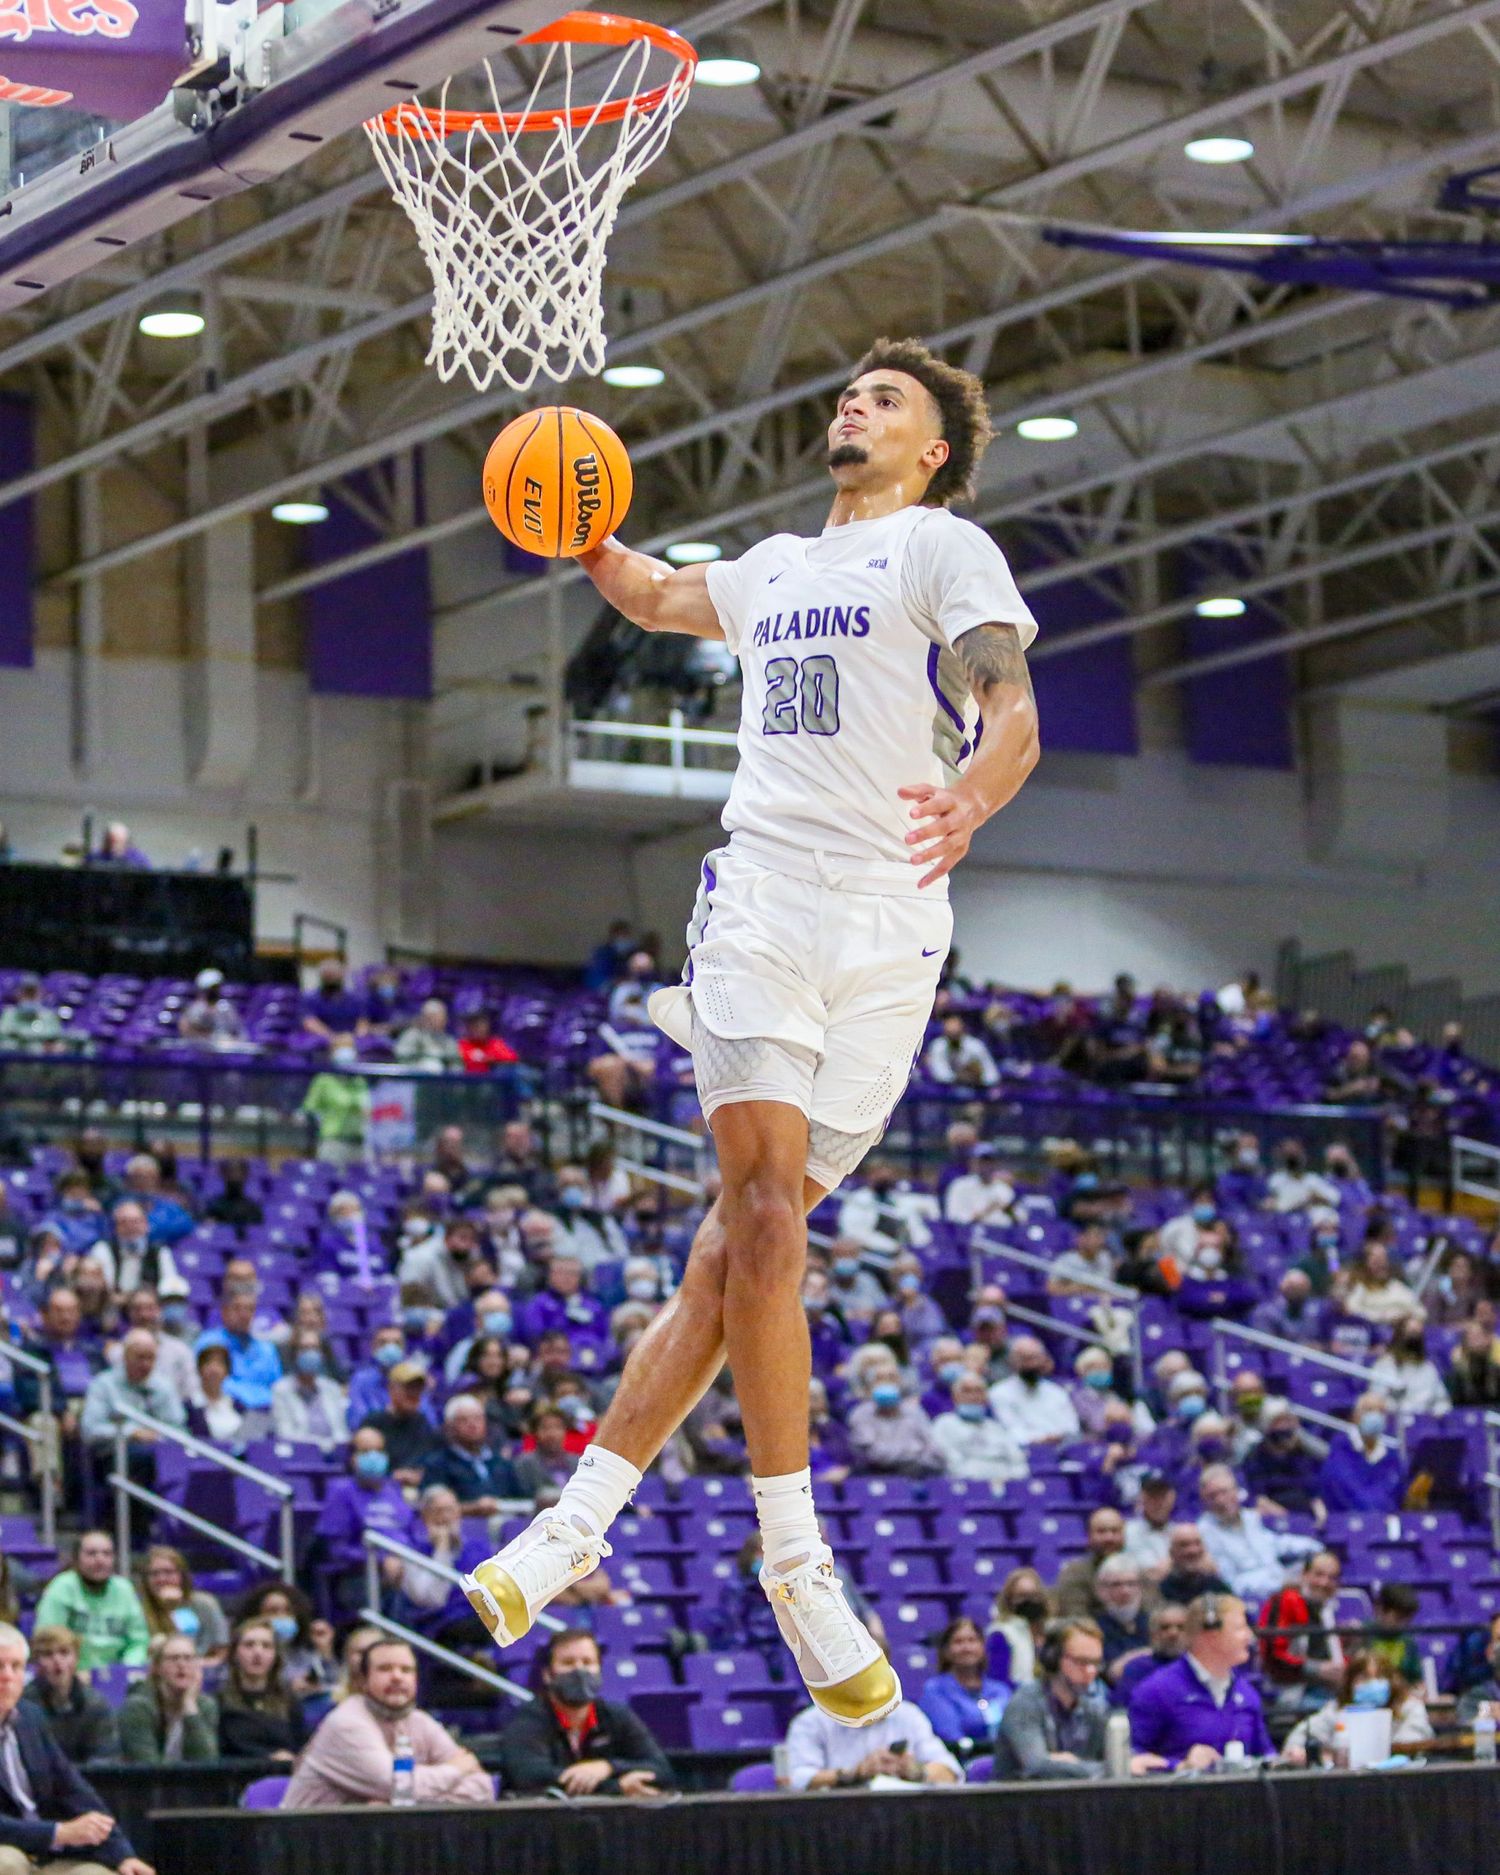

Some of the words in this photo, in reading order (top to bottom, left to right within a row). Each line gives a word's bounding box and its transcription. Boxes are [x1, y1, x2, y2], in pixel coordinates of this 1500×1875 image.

[524, 477, 543, 536] EVO
[570, 453, 601, 548] Wilson
[754, 606, 870, 647] PALADINS
[763, 654, 840, 736] 20
